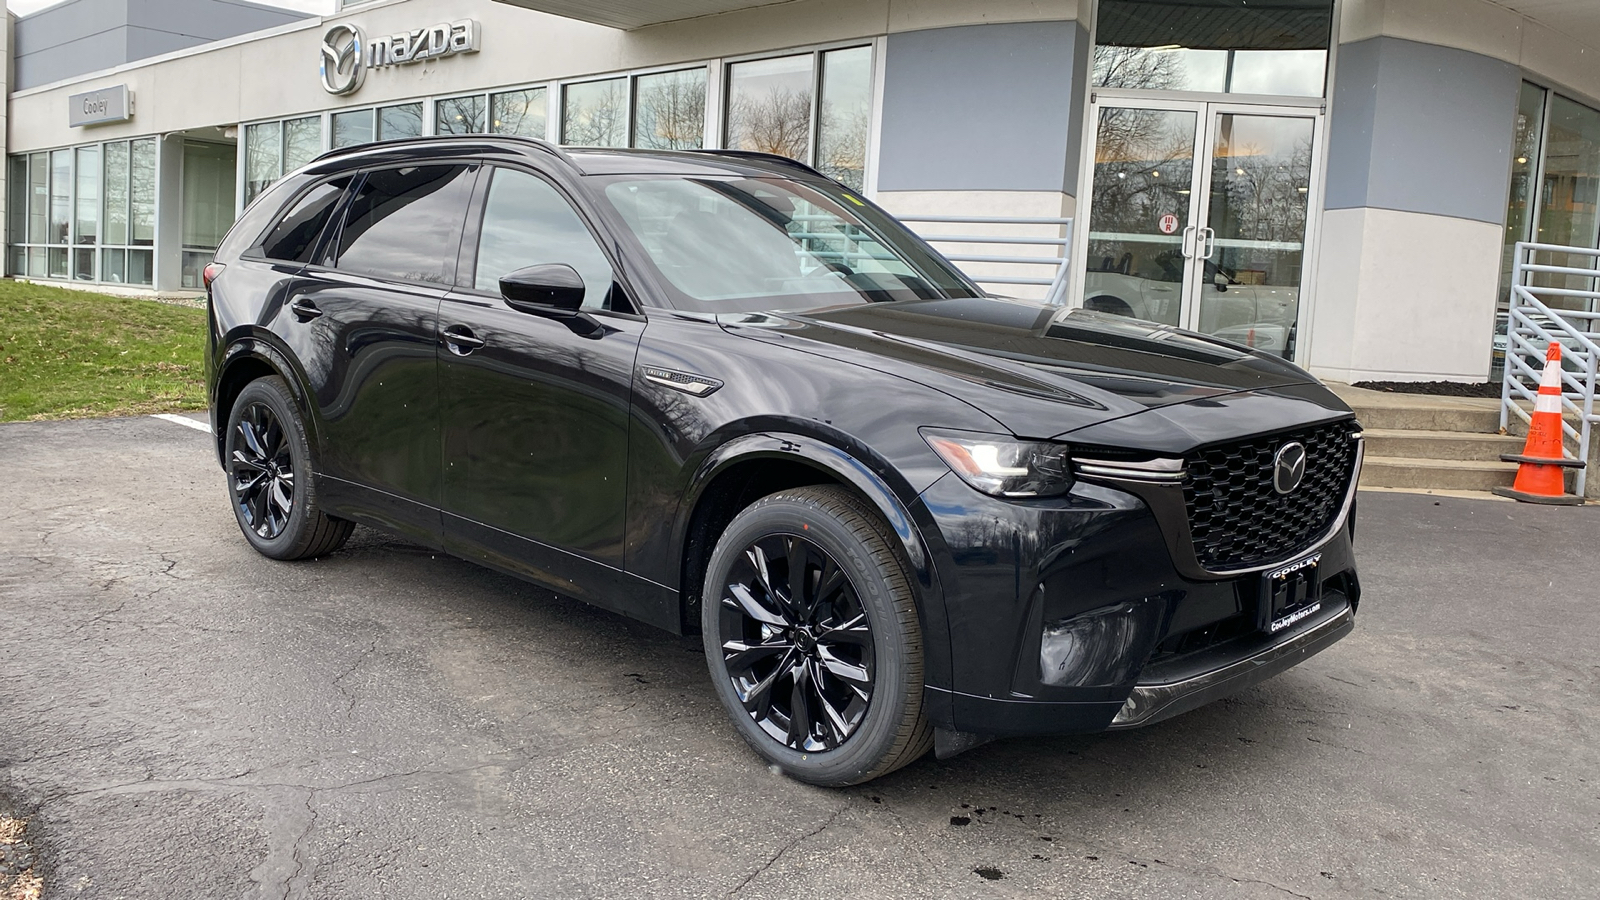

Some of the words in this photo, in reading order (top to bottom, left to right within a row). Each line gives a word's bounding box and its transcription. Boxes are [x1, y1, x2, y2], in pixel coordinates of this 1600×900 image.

[83, 93, 108, 117] Cooley
[846, 547, 879, 596] TOYO
[1272, 553, 1322, 579] COOLEY
[1271, 603, 1321, 632] CooleyMotors.com
